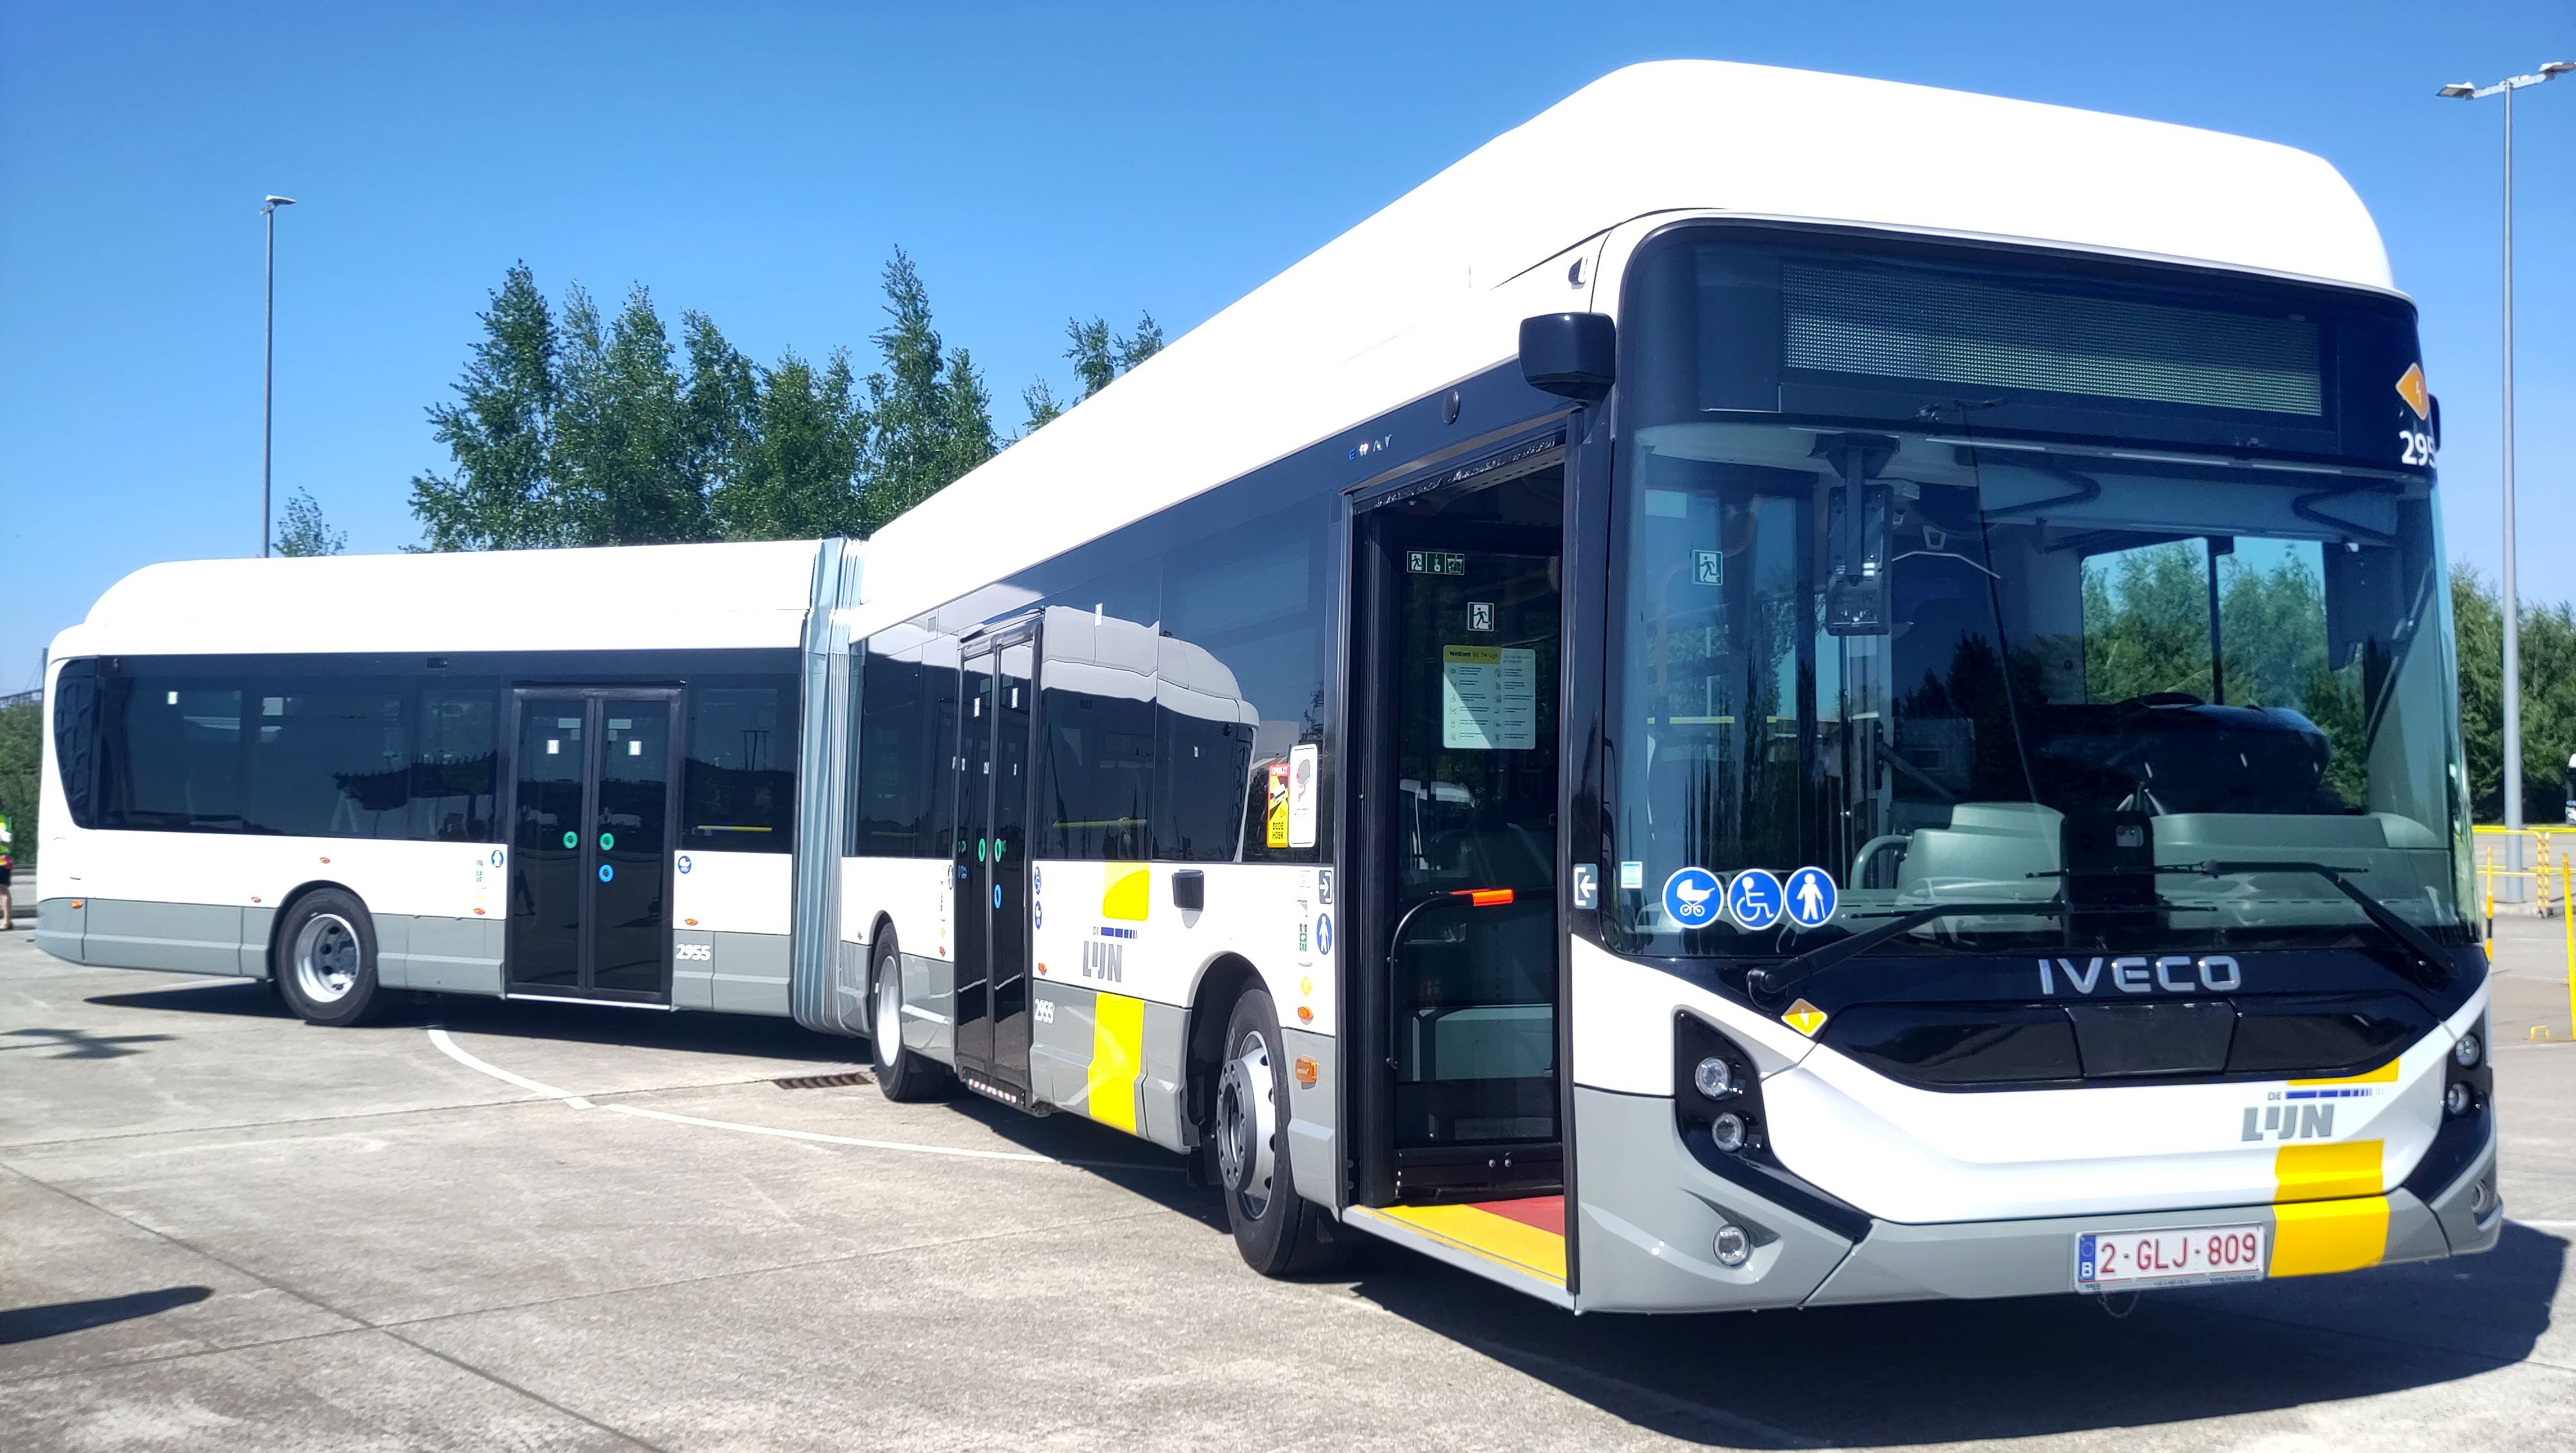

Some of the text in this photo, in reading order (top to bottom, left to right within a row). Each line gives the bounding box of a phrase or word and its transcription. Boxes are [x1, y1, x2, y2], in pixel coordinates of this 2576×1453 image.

[1273, 822, 1284, 830] DODE
[676, 944, 711, 961] 2955
[2038, 956, 2242, 994] IVECO
[2267, 1091, 2282, 1101] DE
[2081, 1261, 2093, 1277] B
